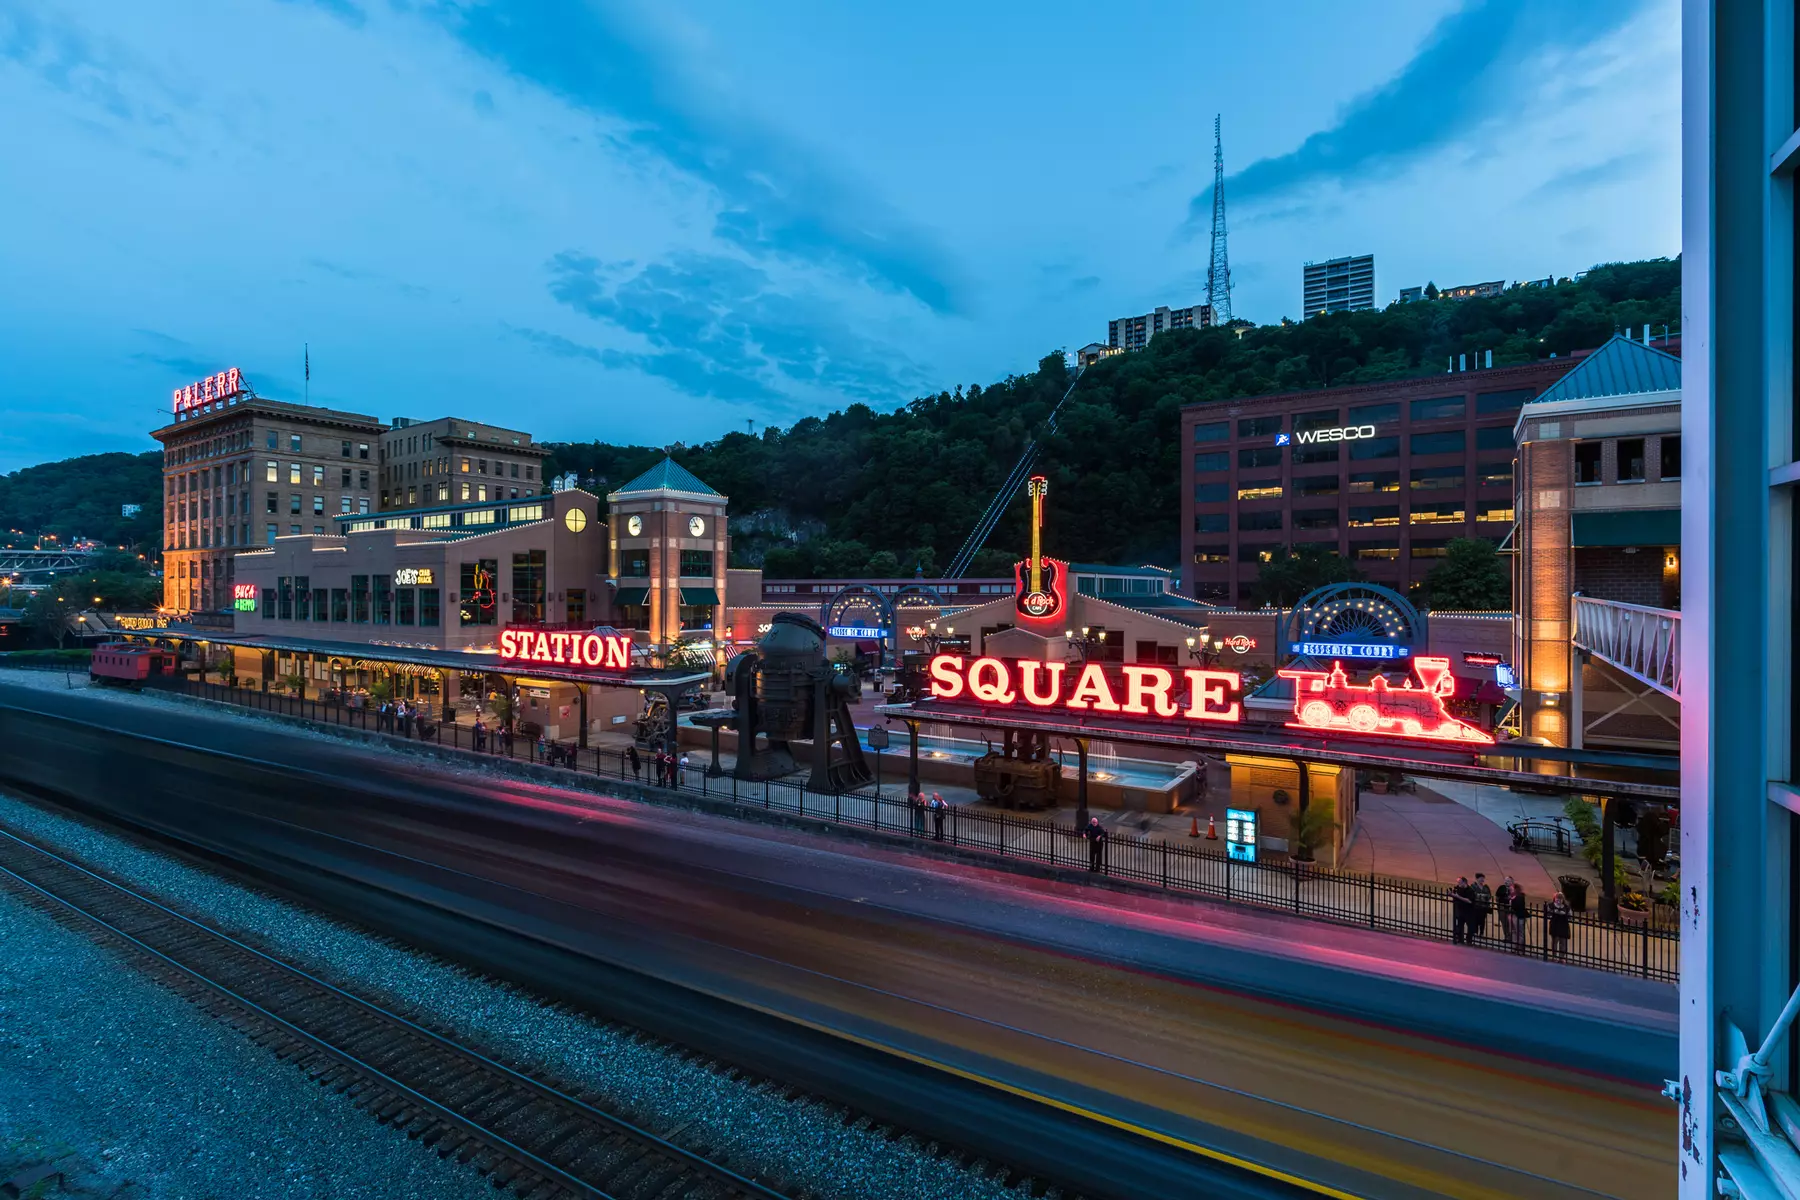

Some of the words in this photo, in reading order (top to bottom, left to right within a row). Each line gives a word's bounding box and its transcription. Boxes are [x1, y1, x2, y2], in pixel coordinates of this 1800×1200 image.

[1297, 425, 1375, 444] WESCO
[395, 568, 418, 586] JOE'S
[234, 584, 255, 599] BUCA
[500, 629, 632, 669] STATION
[1224, 637, 1241, 646] Hard
[1240, 638, 1256, 649] Rock
[1303, 643, 1353, 656] BESSEMER
[1360, 645, 1394, 658] COURT
[929, 653, 1242, 723] SQUARE
